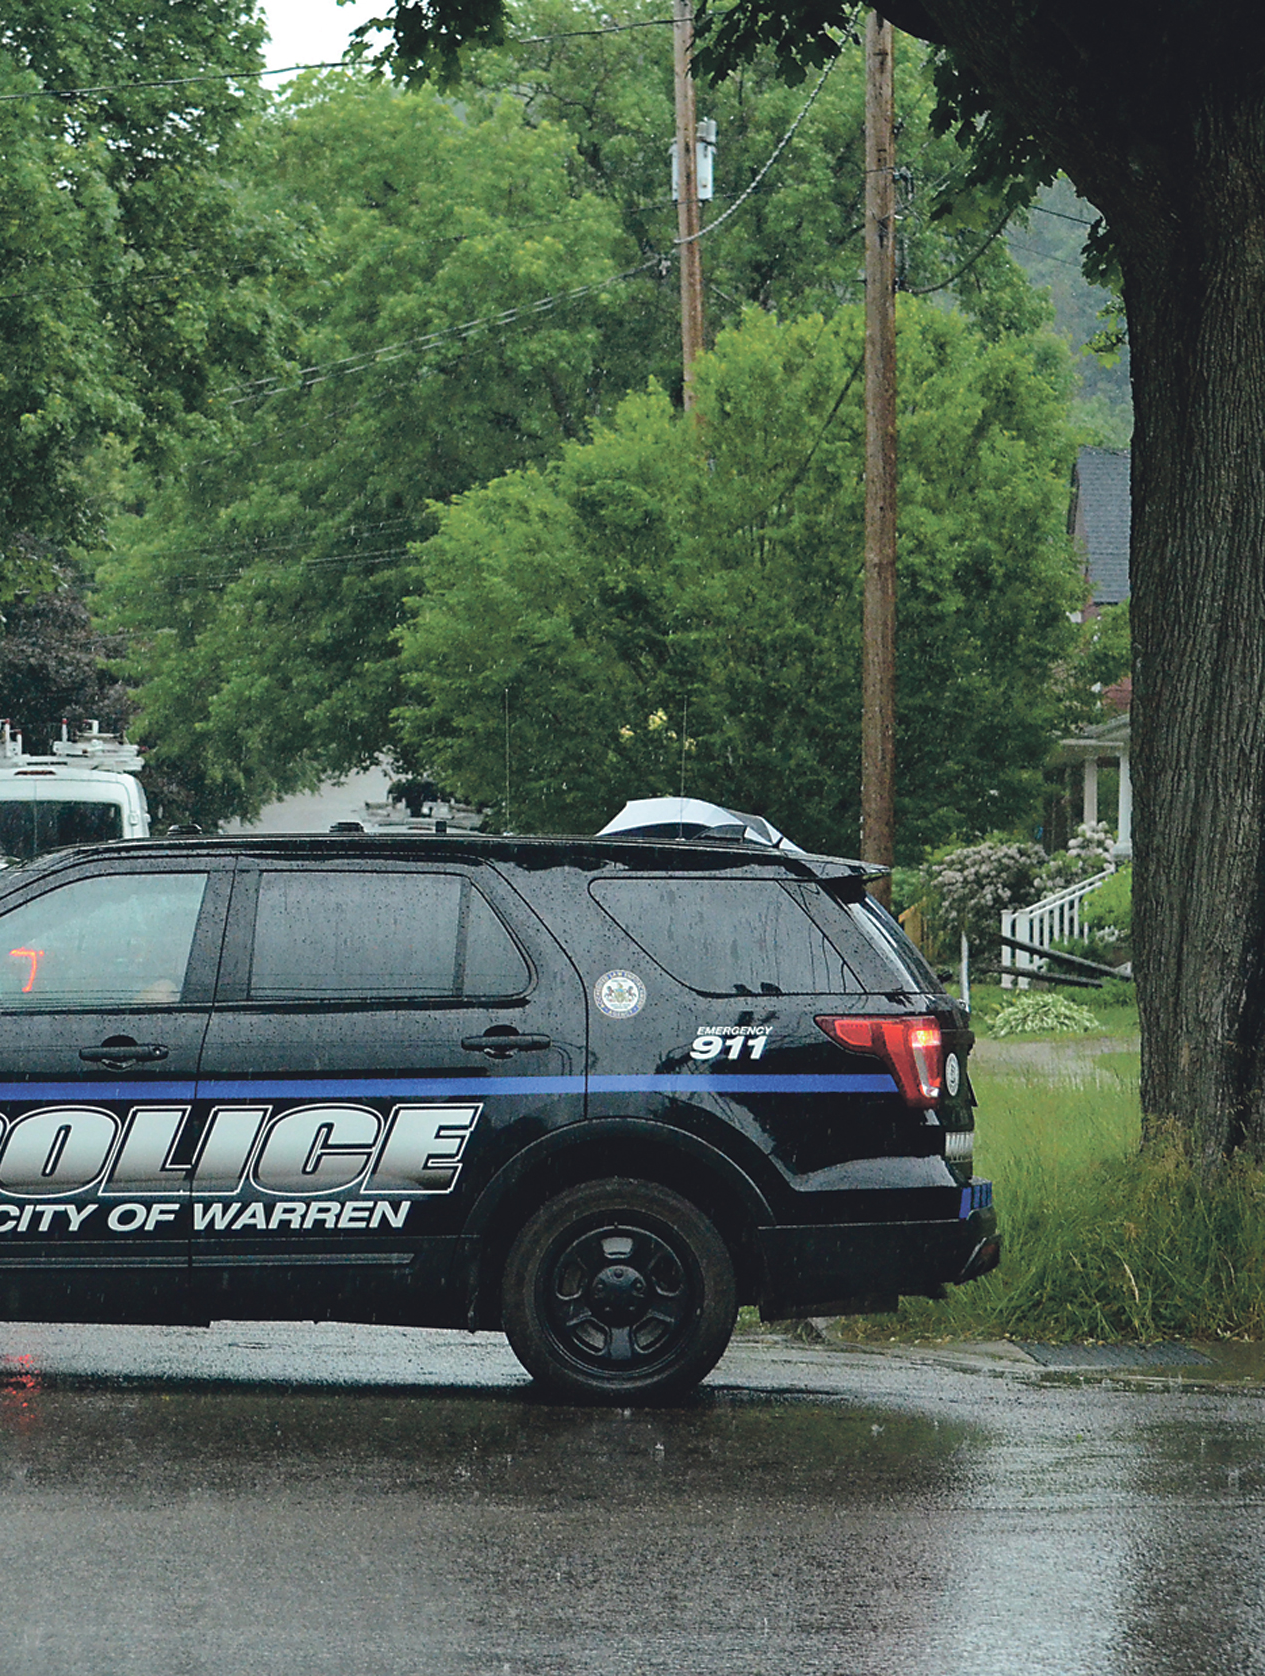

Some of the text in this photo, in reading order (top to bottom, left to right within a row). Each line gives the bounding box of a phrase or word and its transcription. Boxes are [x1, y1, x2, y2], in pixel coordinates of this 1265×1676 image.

[696, 1026, 773, 1036] EMERGENCY
[689, 1035, 768, 1060] 911
[106, 1202, 181, 1232] OF
[192, 1200, 411, 1231] WARREN
